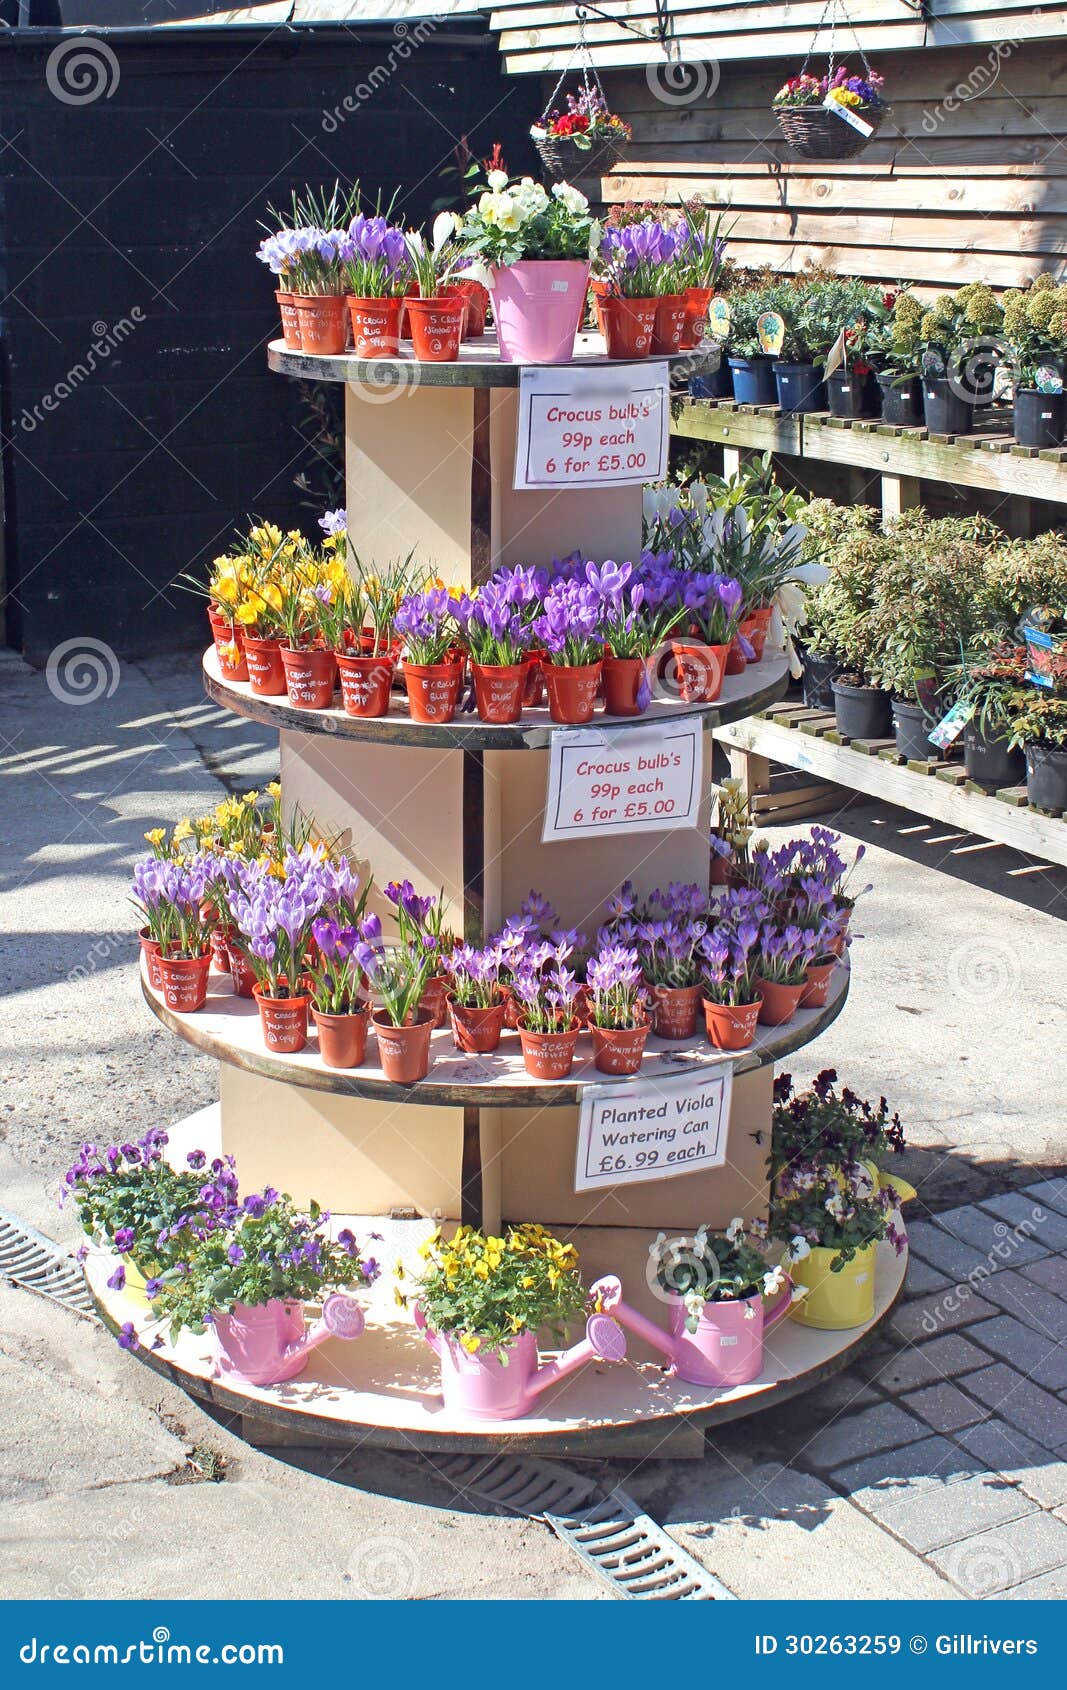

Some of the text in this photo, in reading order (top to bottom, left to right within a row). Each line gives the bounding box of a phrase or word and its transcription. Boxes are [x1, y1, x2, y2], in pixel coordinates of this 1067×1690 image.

[547, 402, 650, 422] Crocus bulb's
[562, 429, 635, 451] 99p each
[546, 452, 646, 473] 6 for £5.00
[576, 751, 681, 776] Crocus bulb's
[591, 777, 664, 800] 99p each
[573, 799, 675, 822] 6 for £5.00
[601, 1094, 714, 1124] Planted Viola
[602, 1120, 709, 1147] Watering Can
[599, 1140, 706, 1172] £6.99 each
